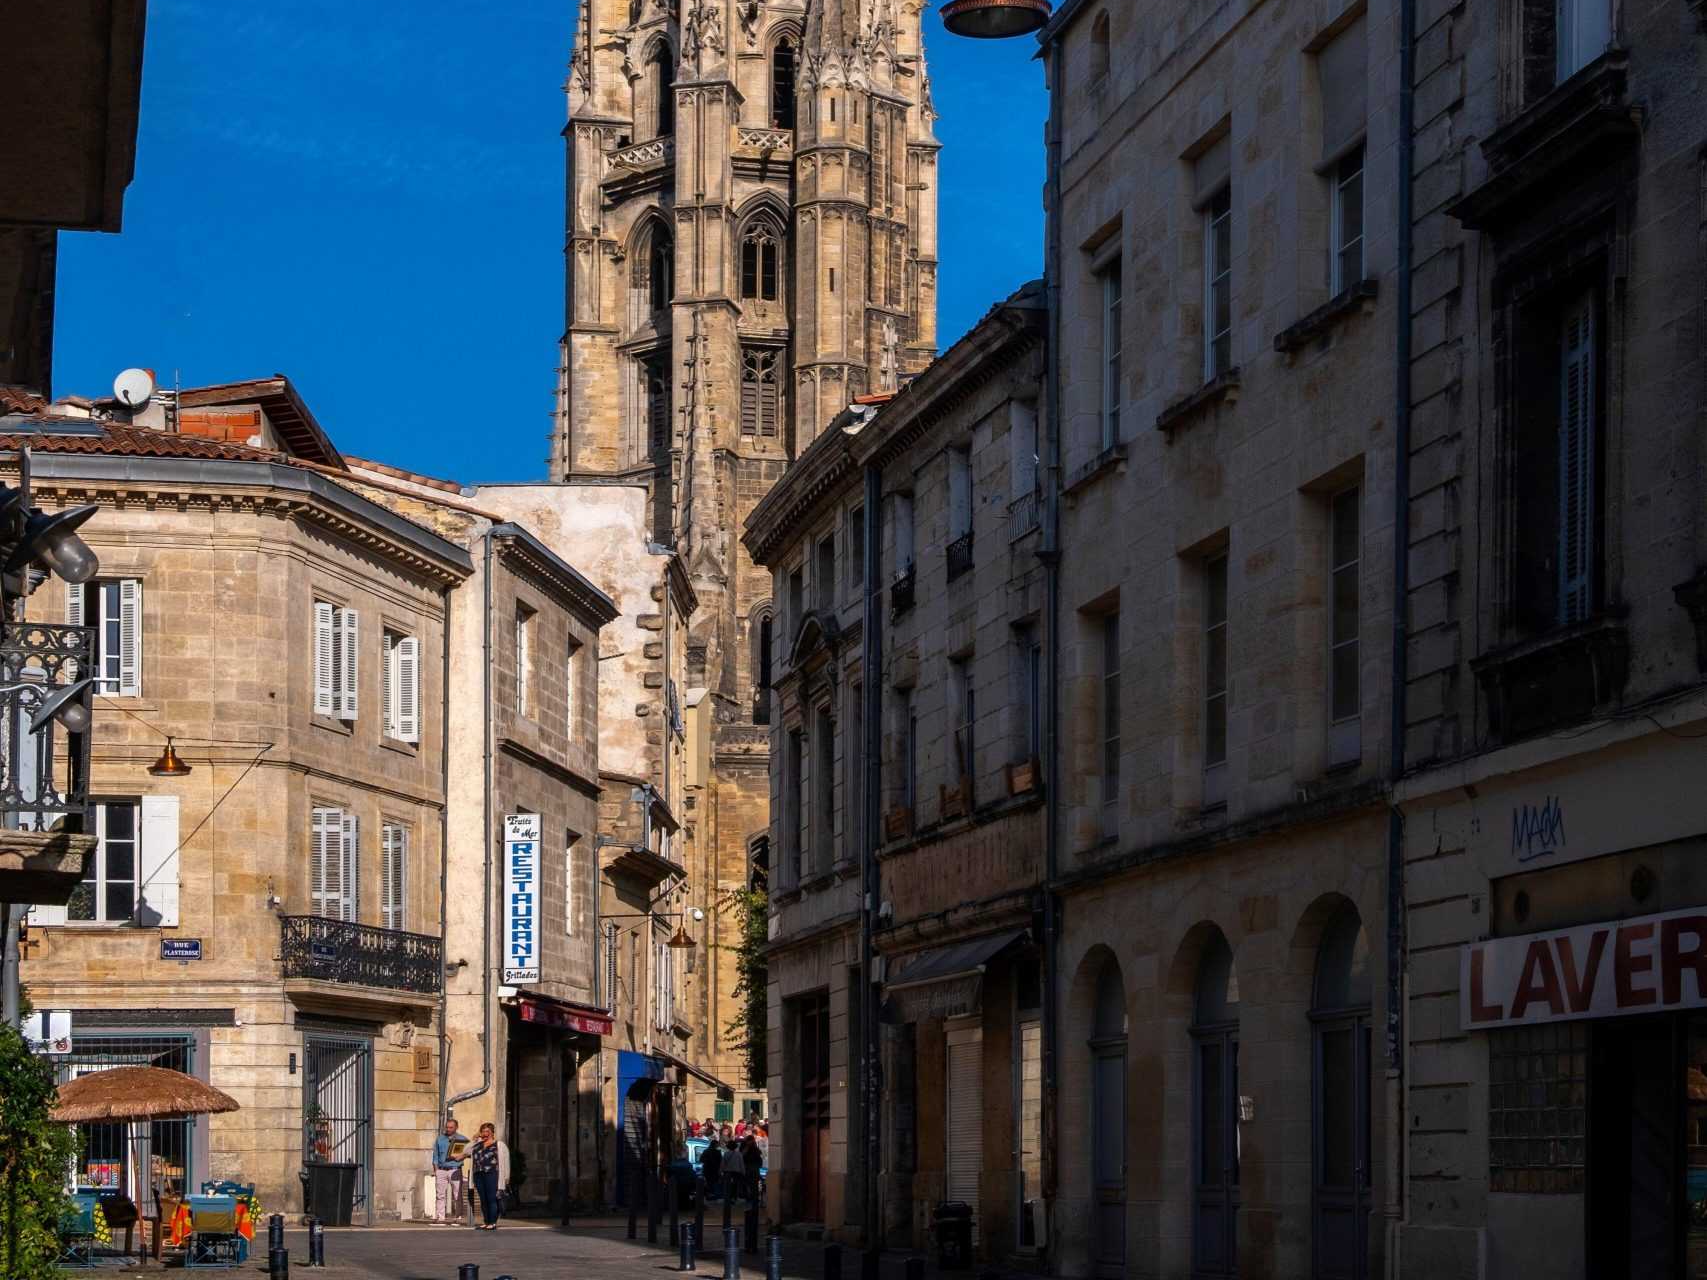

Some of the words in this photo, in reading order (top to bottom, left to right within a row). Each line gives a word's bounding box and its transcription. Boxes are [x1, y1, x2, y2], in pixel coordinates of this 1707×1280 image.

[512, 842, 533, 967] RESTAURANT
[505, 970, 537, 982] Grillades
[1470, 916, 1707, 1022] LAVER
